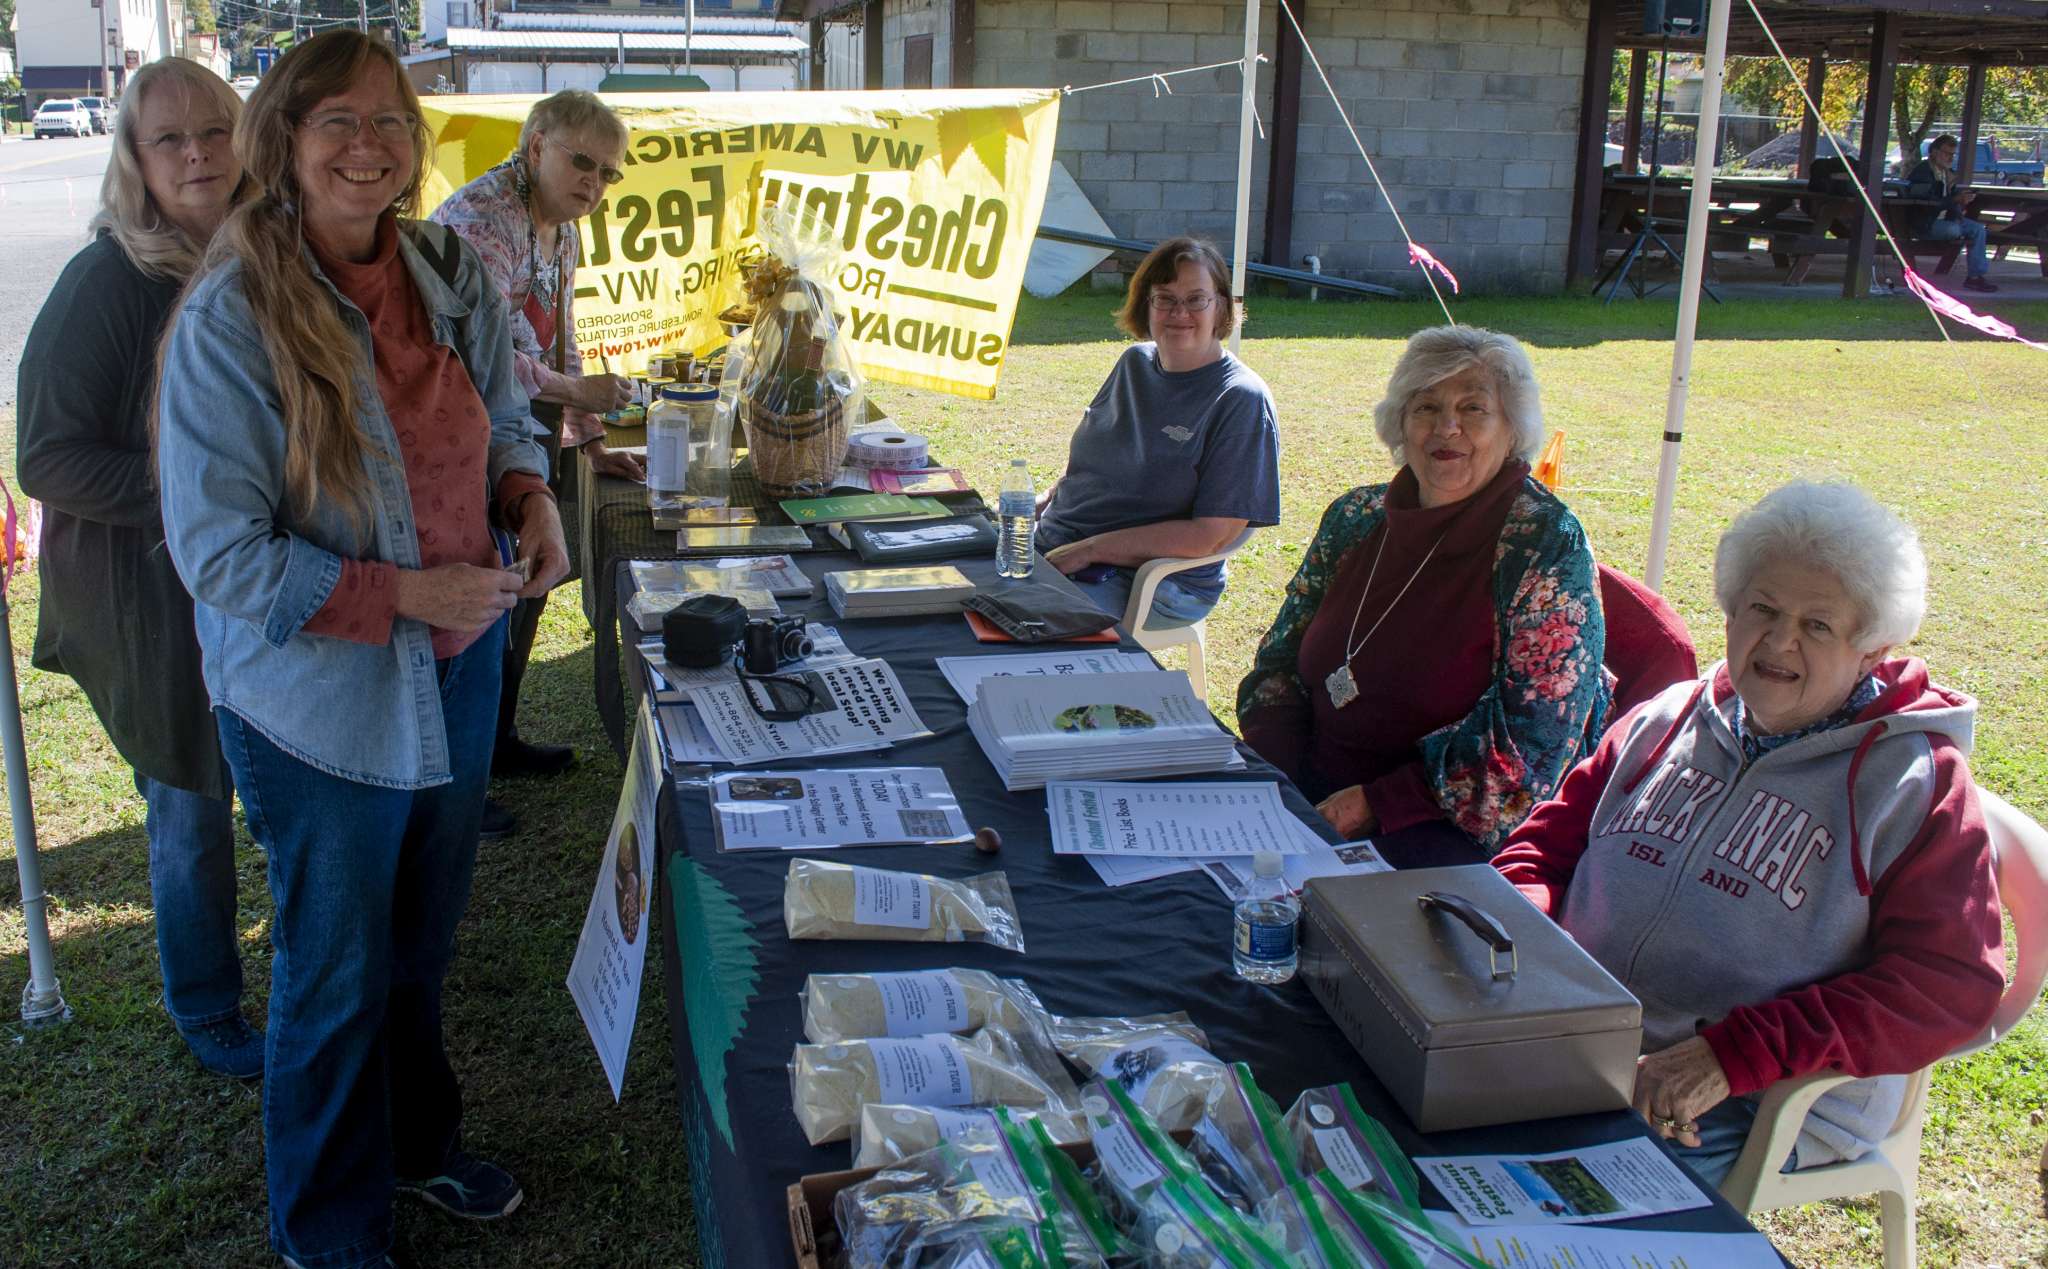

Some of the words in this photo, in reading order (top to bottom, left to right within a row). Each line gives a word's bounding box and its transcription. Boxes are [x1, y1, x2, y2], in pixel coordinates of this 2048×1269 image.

[825, 672, 846, 696] local
[840, 699, 863, 727] Stop!
[853, 666, 892, 724] everything
[872, 668, 885, 685] We
[881, 687, 901, 713] have
[844, 676, 866, 703] need
[860, 706, 871, 717] in
[868, 719, 885, 736] one
[718, 690, 756, 747] 304-864-5231
[726, 724, 738, 737] WV
[871, 779, 889, 803] TODAY
[1112, 798, 1131, 817] Books
[1119, 818, 1135, 832] List
[1123, 829, 1138, 849] Price
[912, 900, 920, 920] FLOUR
[946, 999, 957, 1021] FLOUR
[948, 1070, 961, 1094] FLOUR
[1441, 1163, 1496, 1219] Chestnut
[1460, 1166, 1514, 1216] Festival
